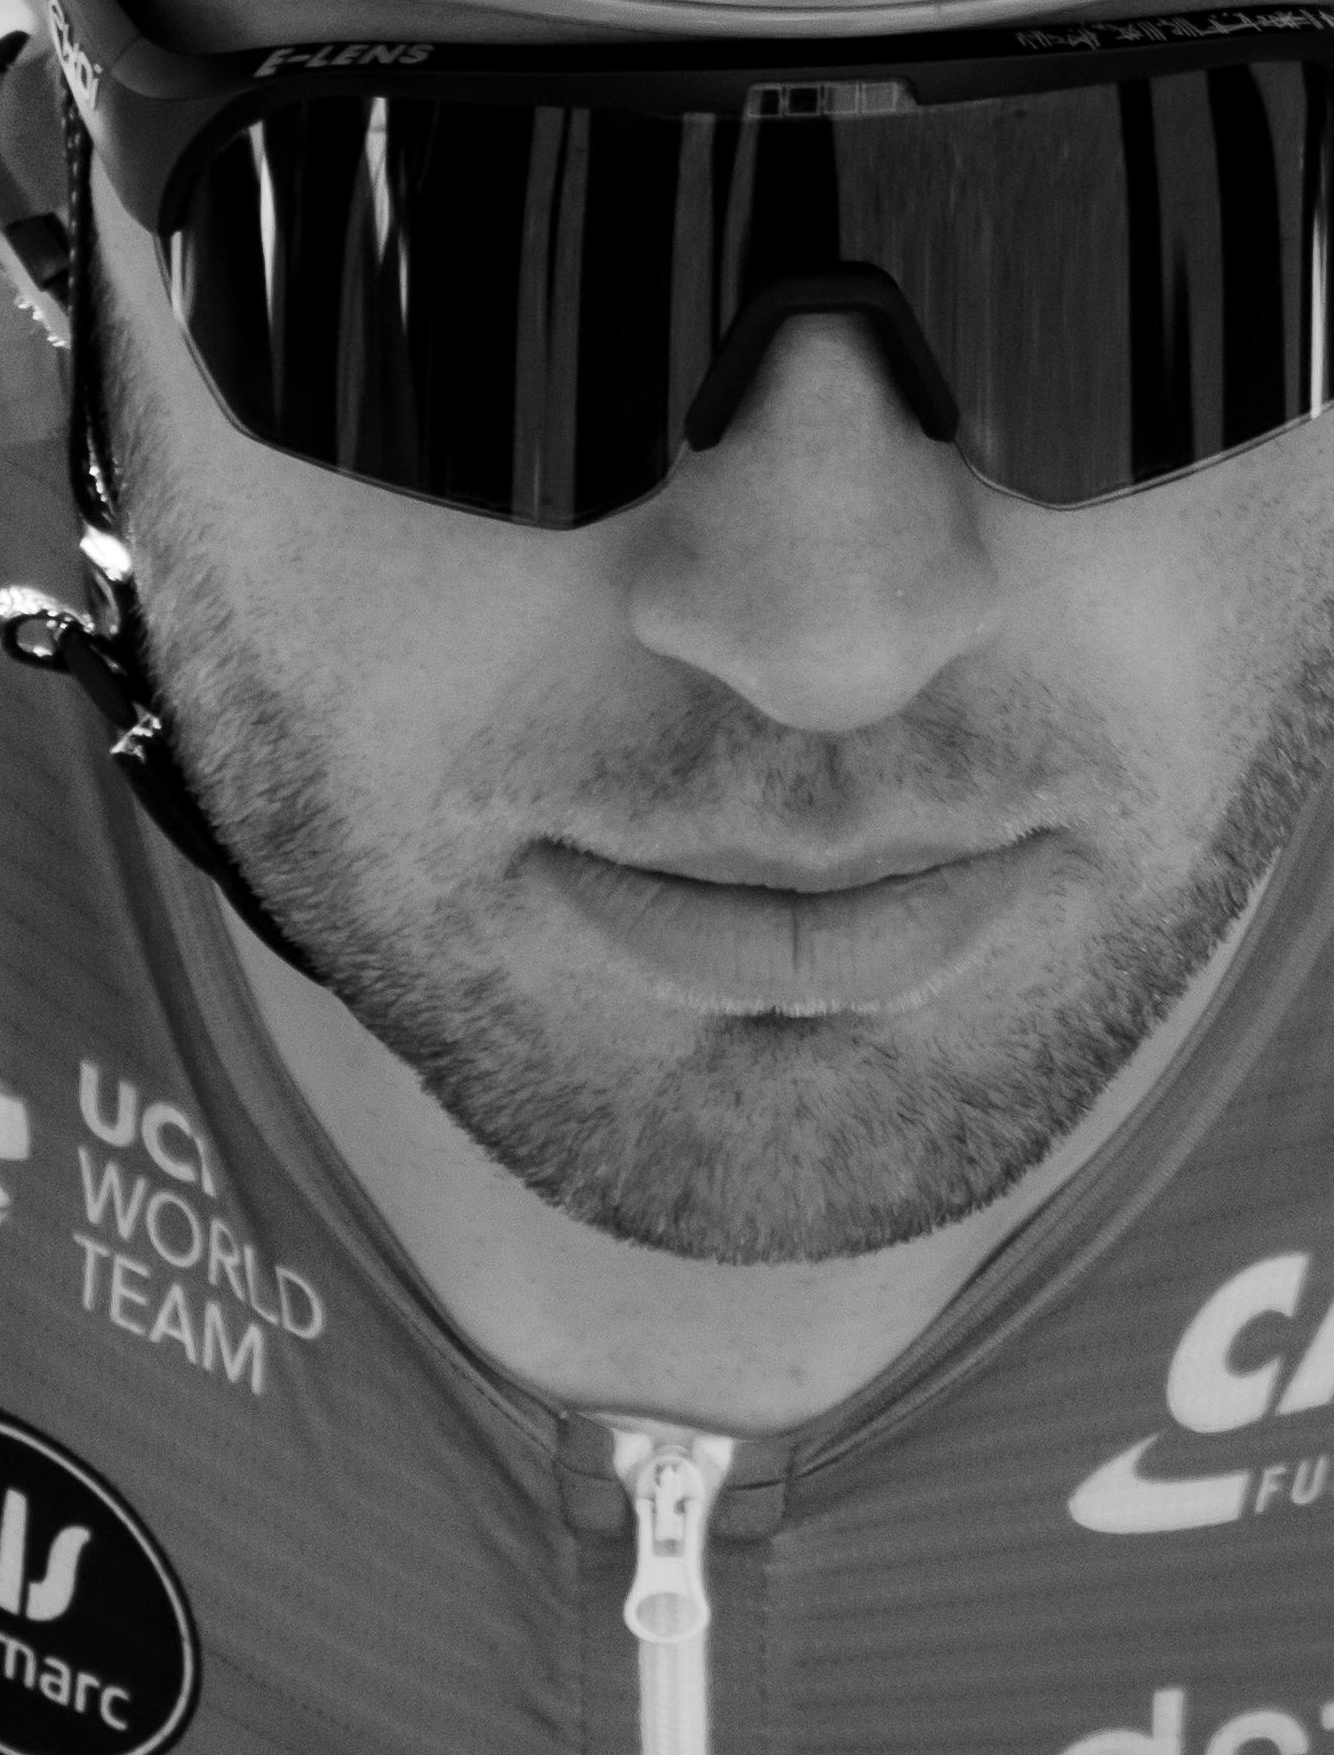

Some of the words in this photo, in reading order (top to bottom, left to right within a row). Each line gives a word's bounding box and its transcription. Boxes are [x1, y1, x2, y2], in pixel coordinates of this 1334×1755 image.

[253, 43, 436, 78] E-LENS
[72, 1233, 266, 1396] TEAM
[77, 1144, 325, 1342] WORLD
